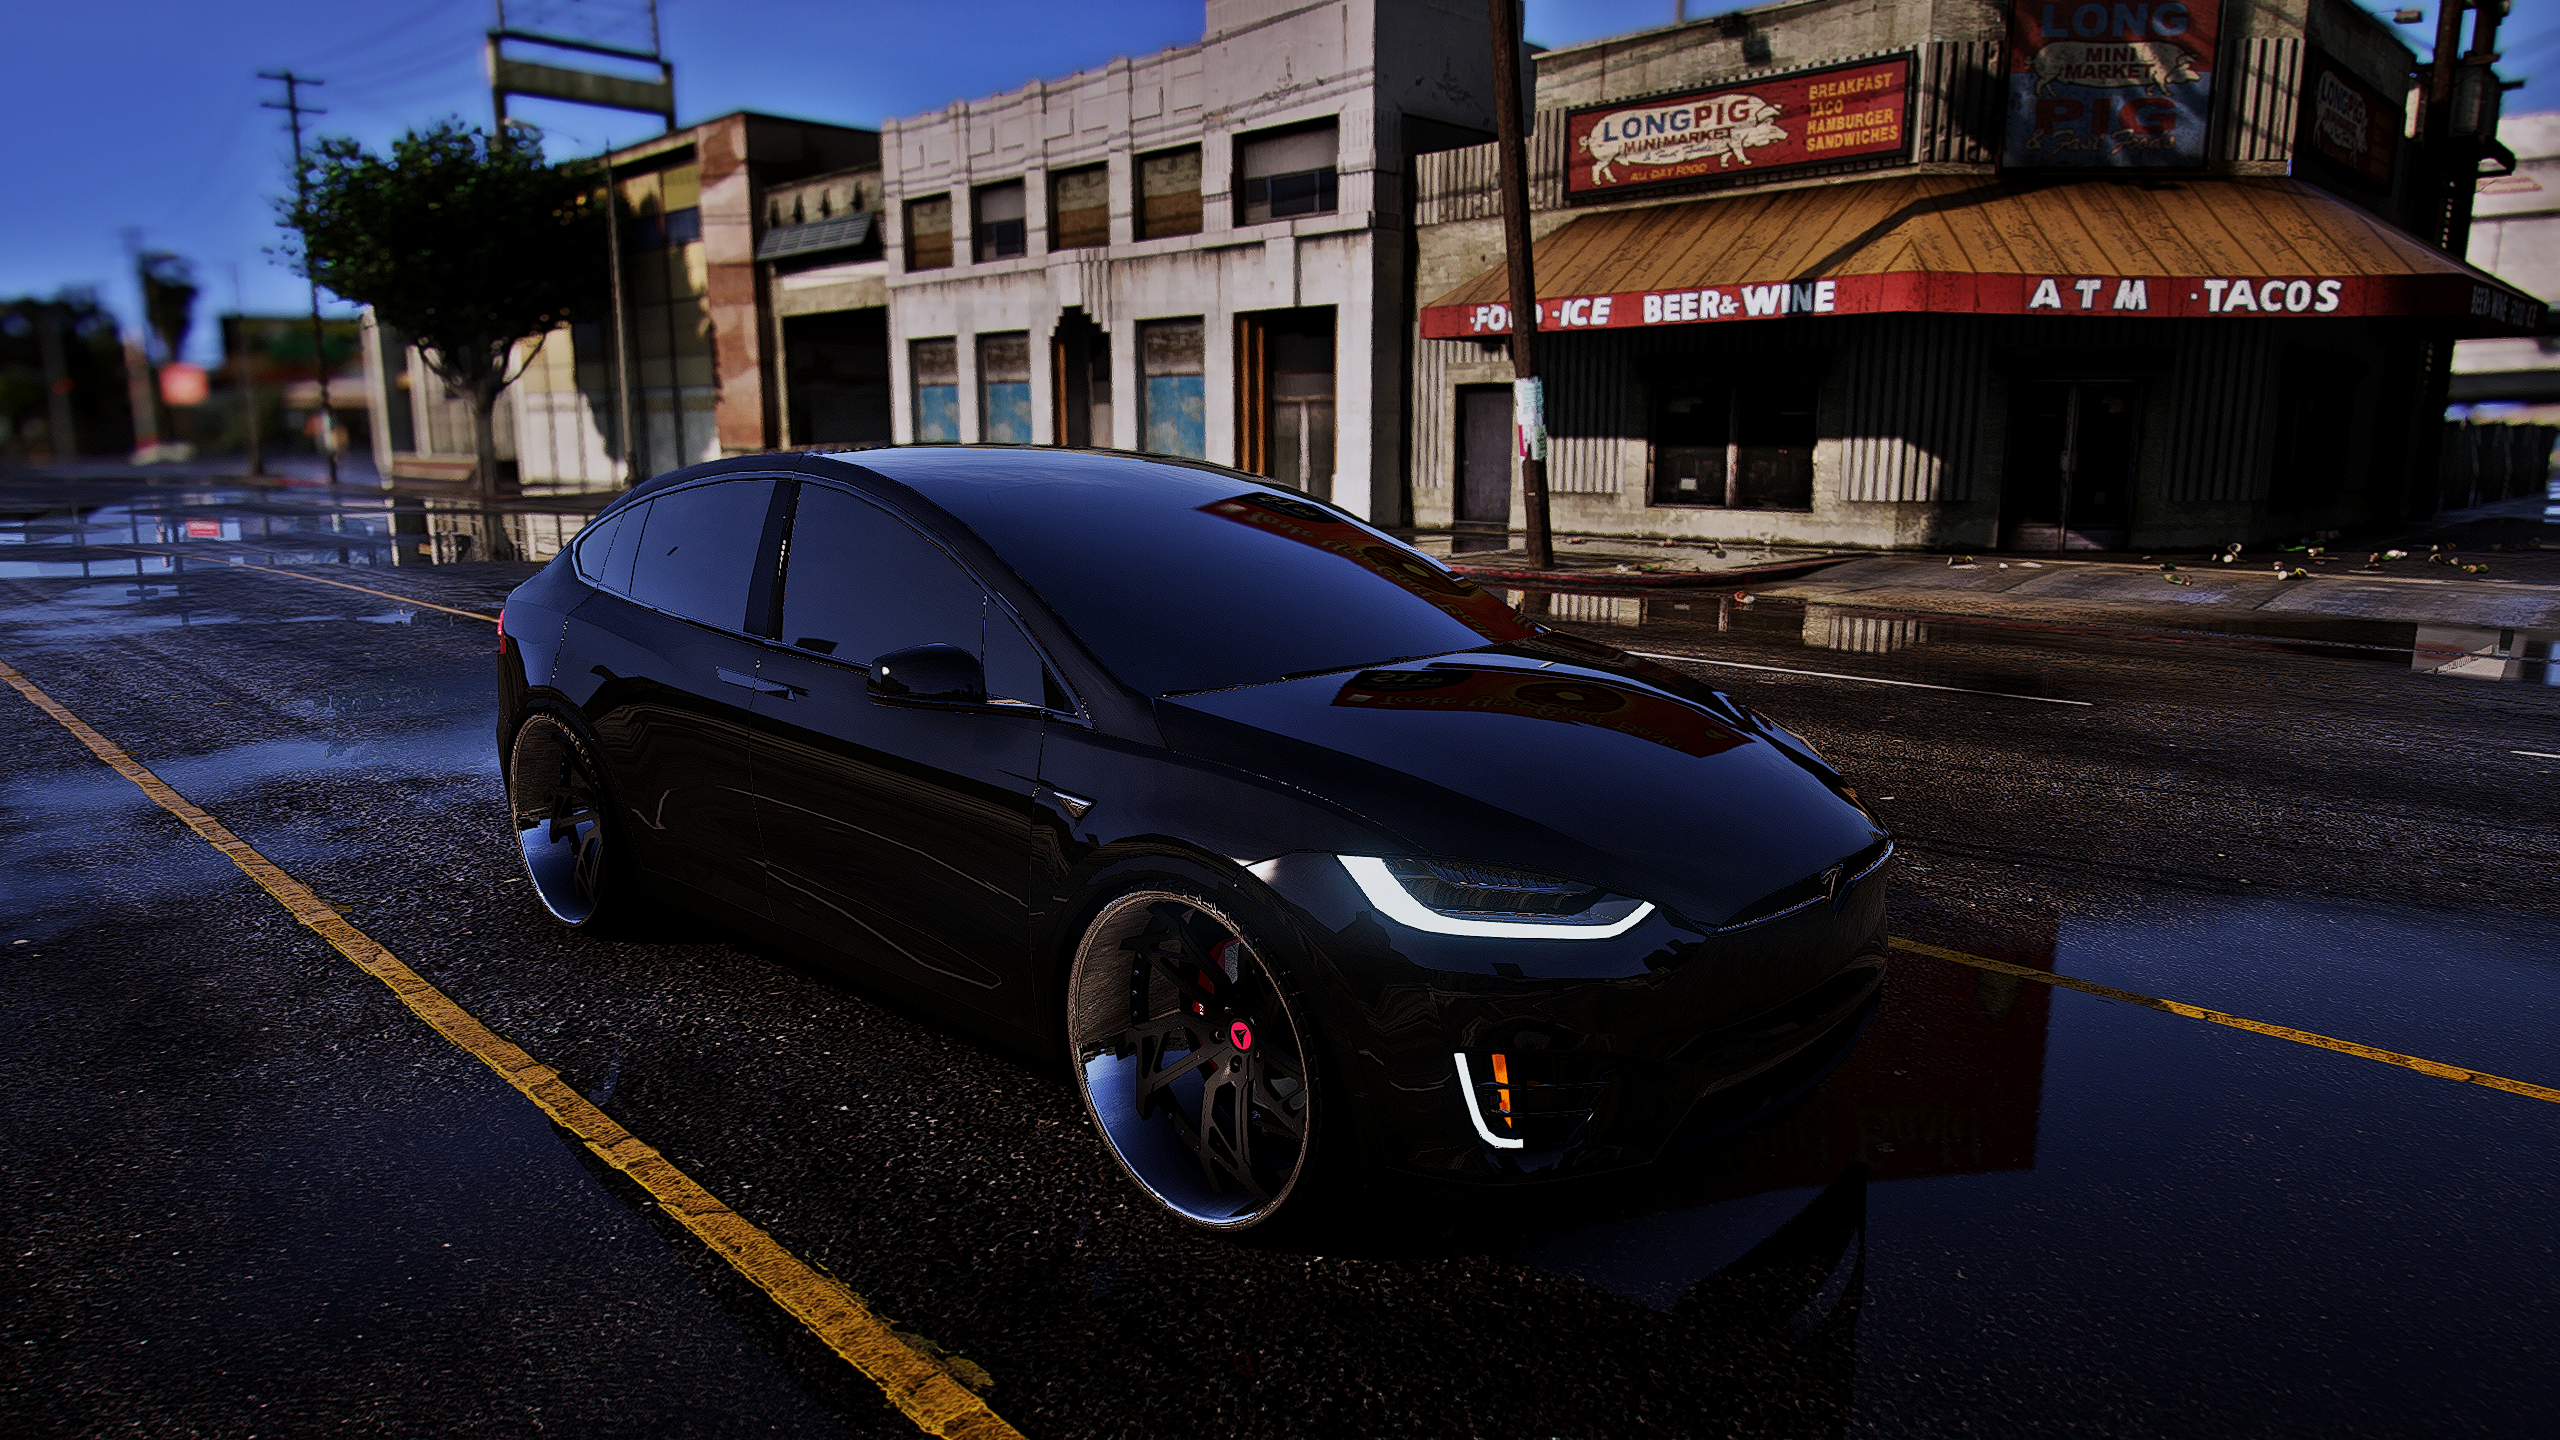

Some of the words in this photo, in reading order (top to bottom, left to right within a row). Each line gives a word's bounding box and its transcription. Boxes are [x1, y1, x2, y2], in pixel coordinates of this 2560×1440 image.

[2040, 0, 2189, 38] LONG
[2085, 47, 2137, 62] MINI
[2065, 64, 2154, 79] MARKET
[1809, 72, 1893, 101] BREAKFAST
[1806, 108, 1894, 135] HAMBURGER
[1809, 99, 1843, 118] TACO
[2035, 98, 2177, 135] PIG
[1806, 124, 1898, 152] SANDWICHES
